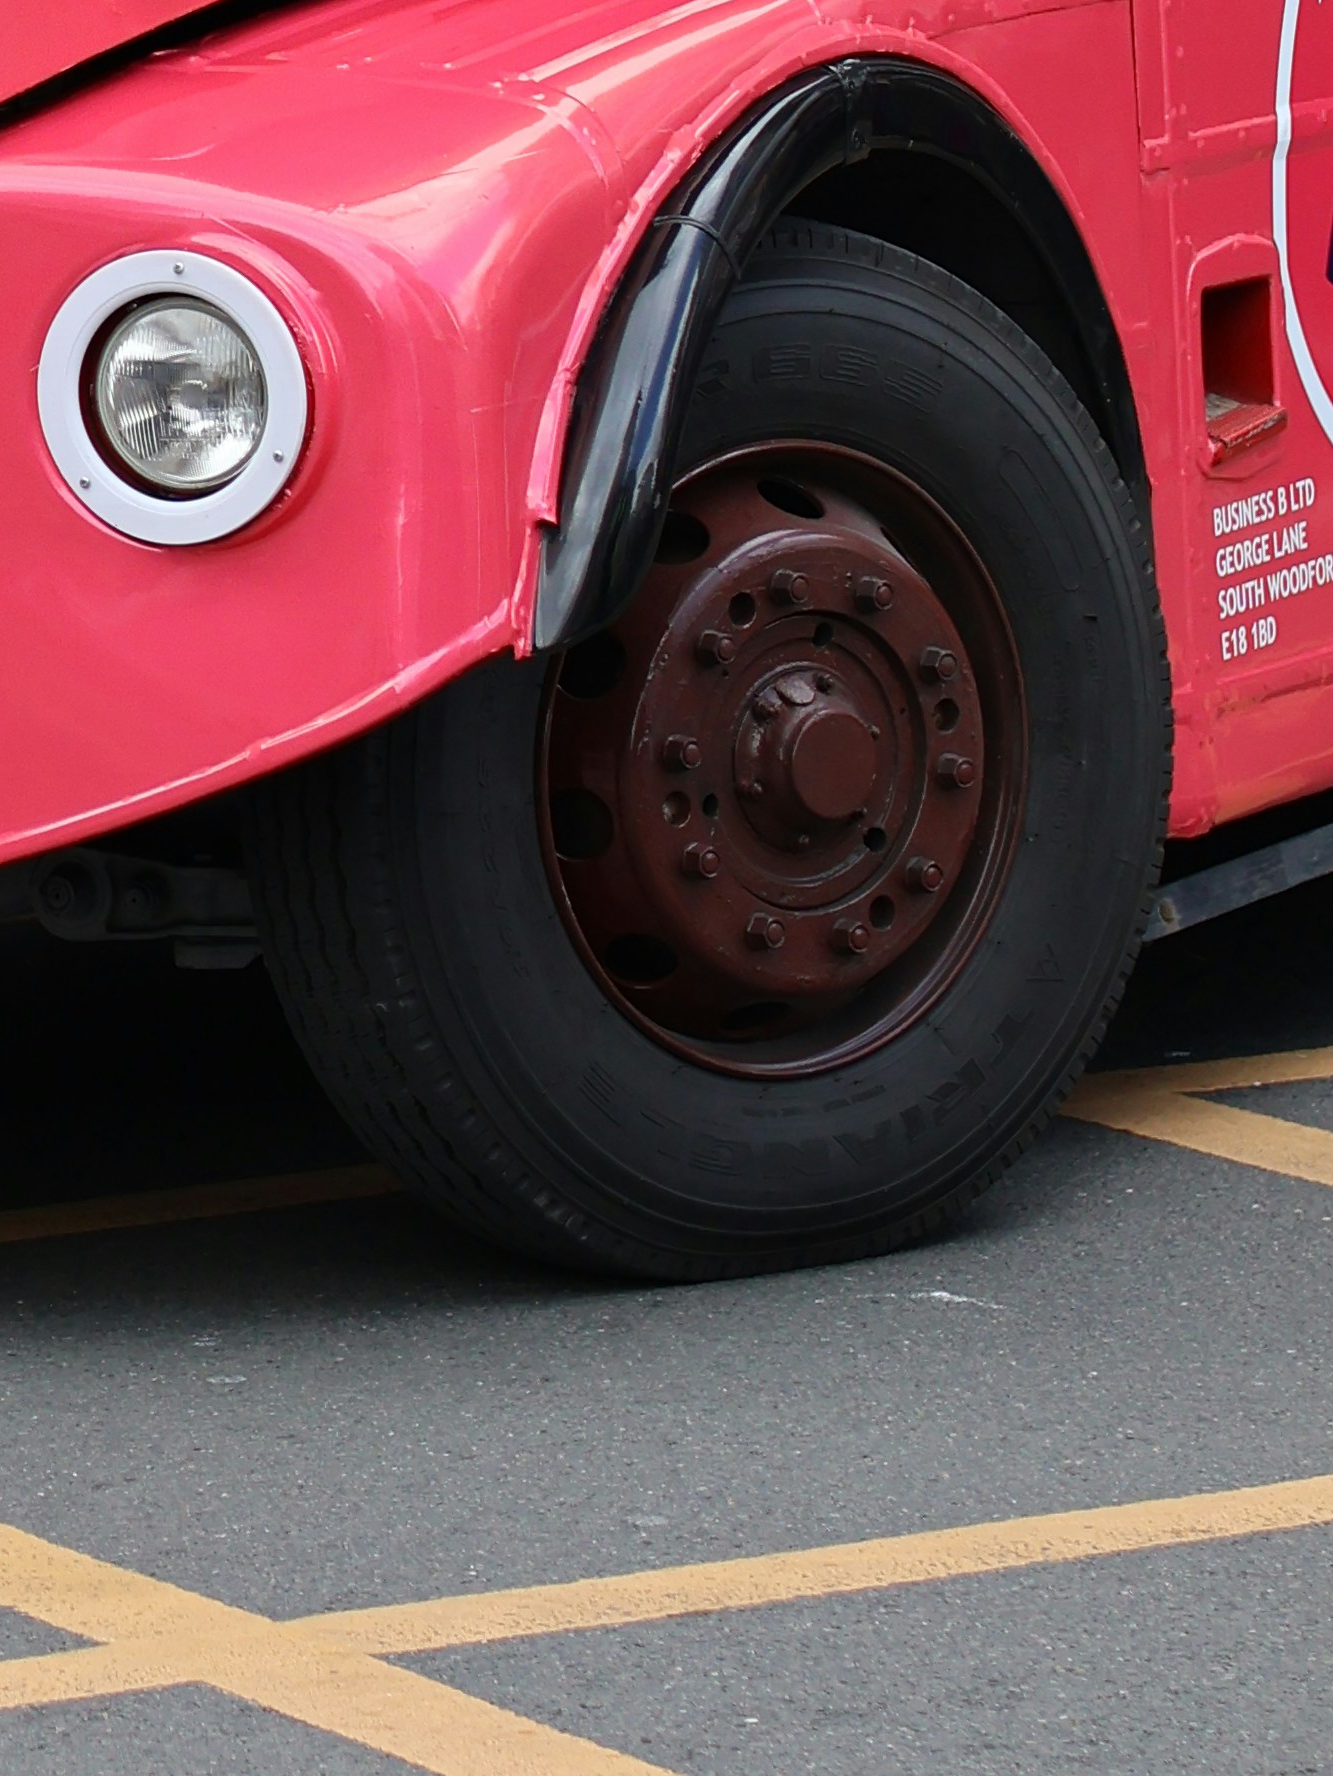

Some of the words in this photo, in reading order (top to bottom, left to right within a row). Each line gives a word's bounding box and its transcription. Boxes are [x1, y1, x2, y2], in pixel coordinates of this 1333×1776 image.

[1213, 490, 1275, 537] BUSINESS
[1277, 486, 1288, 516] B
[1289, 478, 1315, 512] LTD
[1216, 533, 1271, 577] GEORGE
[1273, 521, 1308, 559] LANE
[1218, 577, 1265, 620] SOUTH
[1267, 554, 1333, 603] WOODFOR
[1221, 625, 1248, 661] E18
[1251, 616, 1276, 650] 1BD
